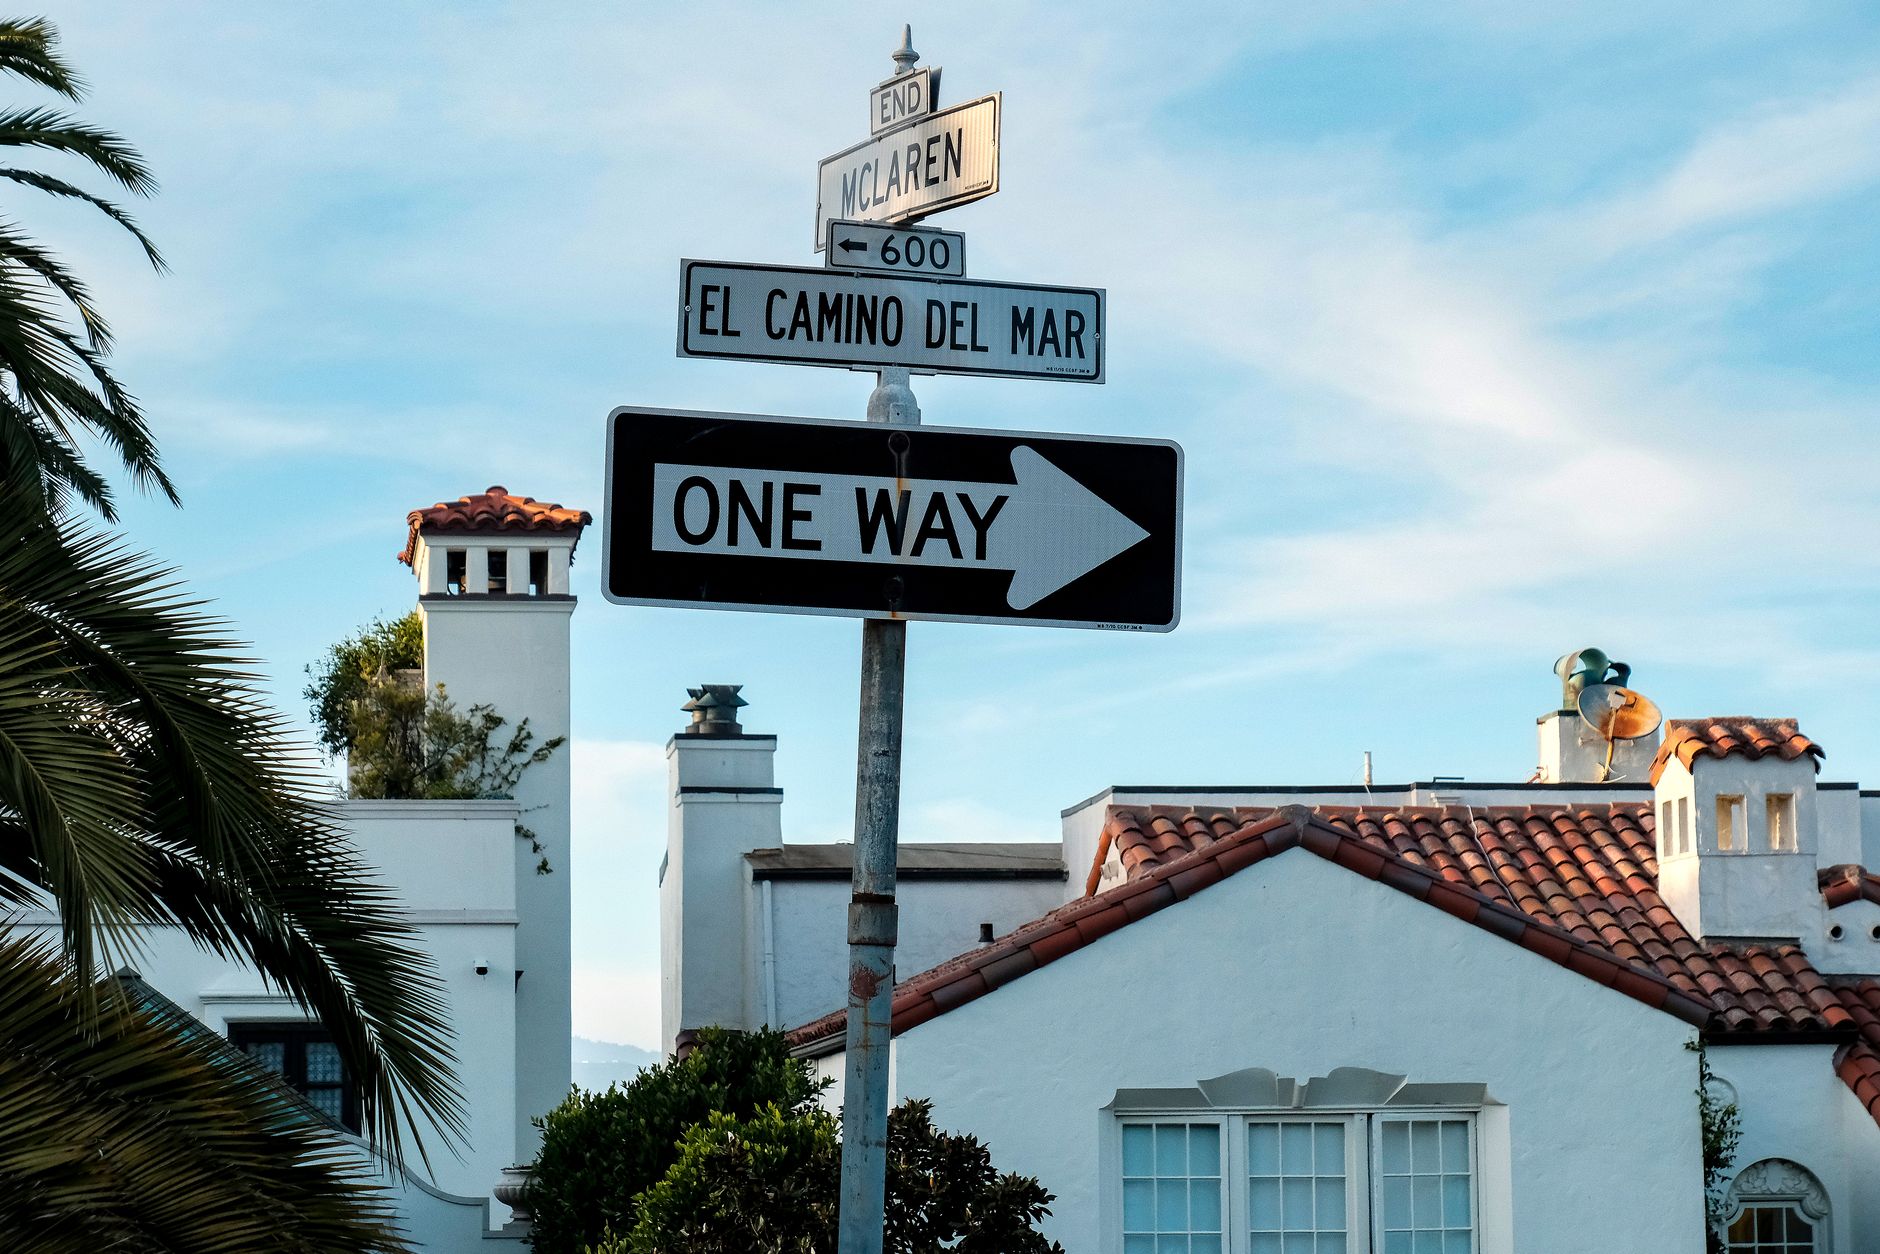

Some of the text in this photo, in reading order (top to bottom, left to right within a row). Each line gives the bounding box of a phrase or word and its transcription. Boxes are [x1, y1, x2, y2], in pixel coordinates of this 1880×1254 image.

[880, 81, 921, 125] END
[841, 128, 963, 217] MCLAREN
[880, 234, 950, 270] 600
[699, 284, 1086, 360] EL CAMINO DEL MAR
[673, 475, 1010, 561] ONE WAY
